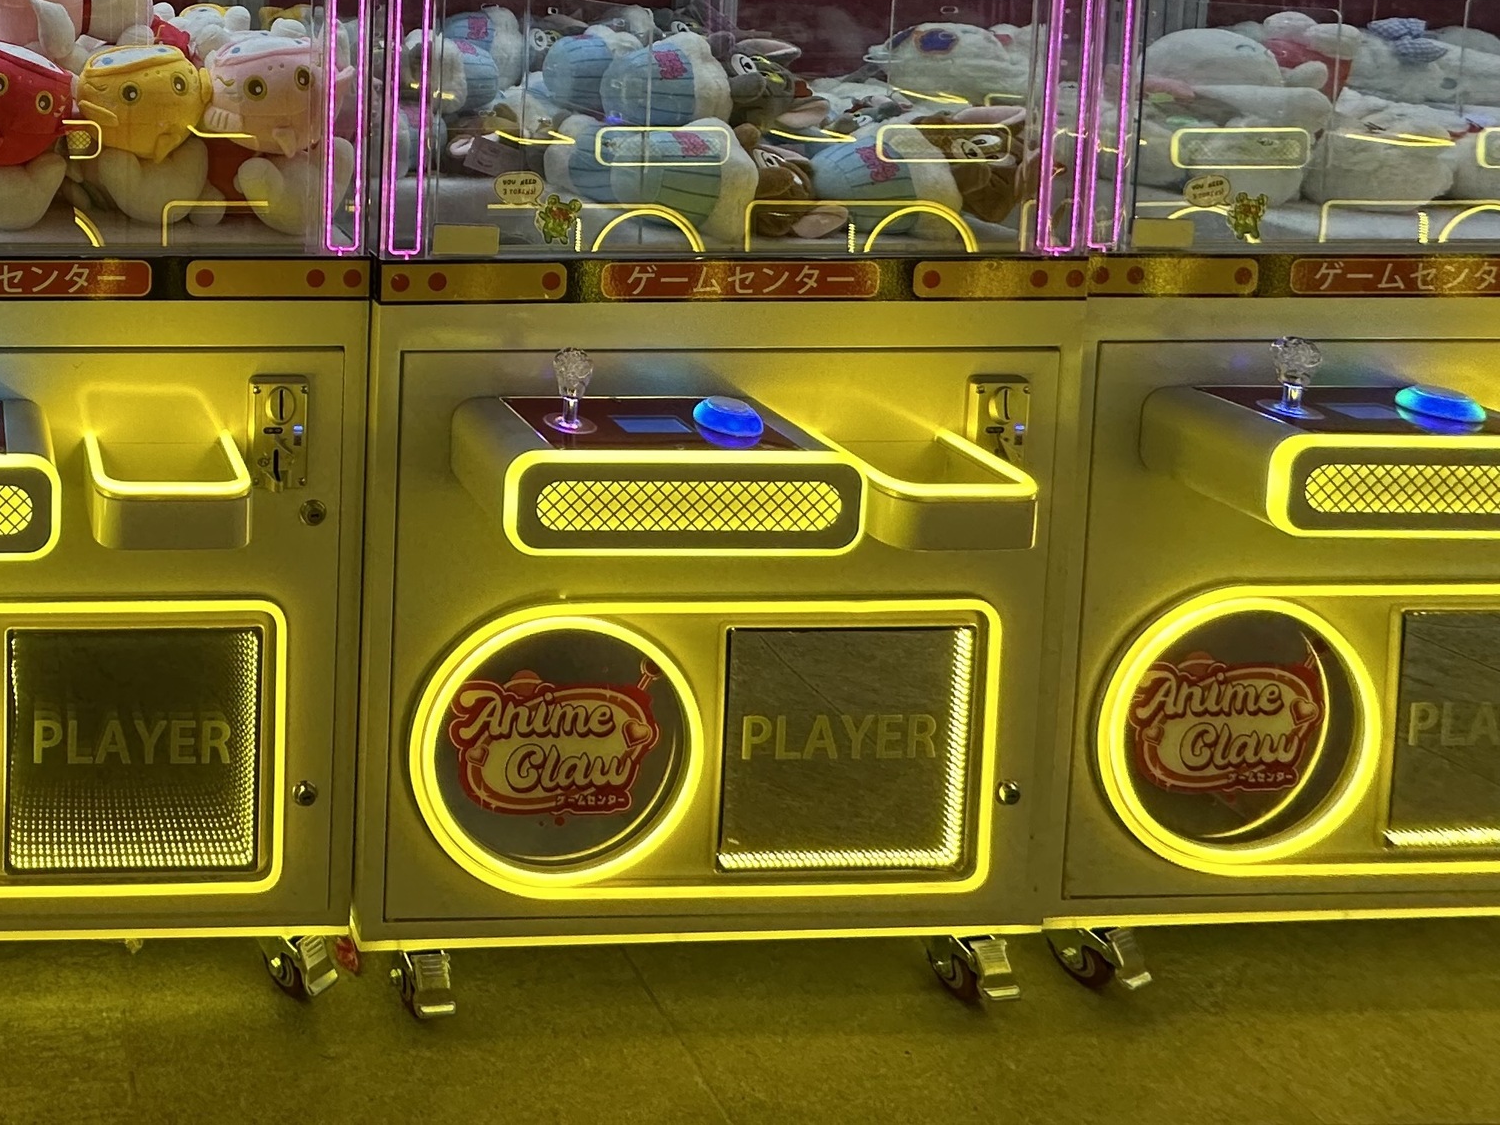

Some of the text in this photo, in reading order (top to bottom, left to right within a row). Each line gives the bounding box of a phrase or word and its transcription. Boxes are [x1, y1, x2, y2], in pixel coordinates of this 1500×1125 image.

[626, 264, 855, 296] ゲームセンター
[458, 689, 616, 739] Anime
[1134, 673, 1285, 721] Anime
[32, 719, 231, 765] PLAYER
[741, 714, 937, 760] PLAYER
[1180, 722, 1299, 772] Claw
[505, 743, 634, 793] Claw
